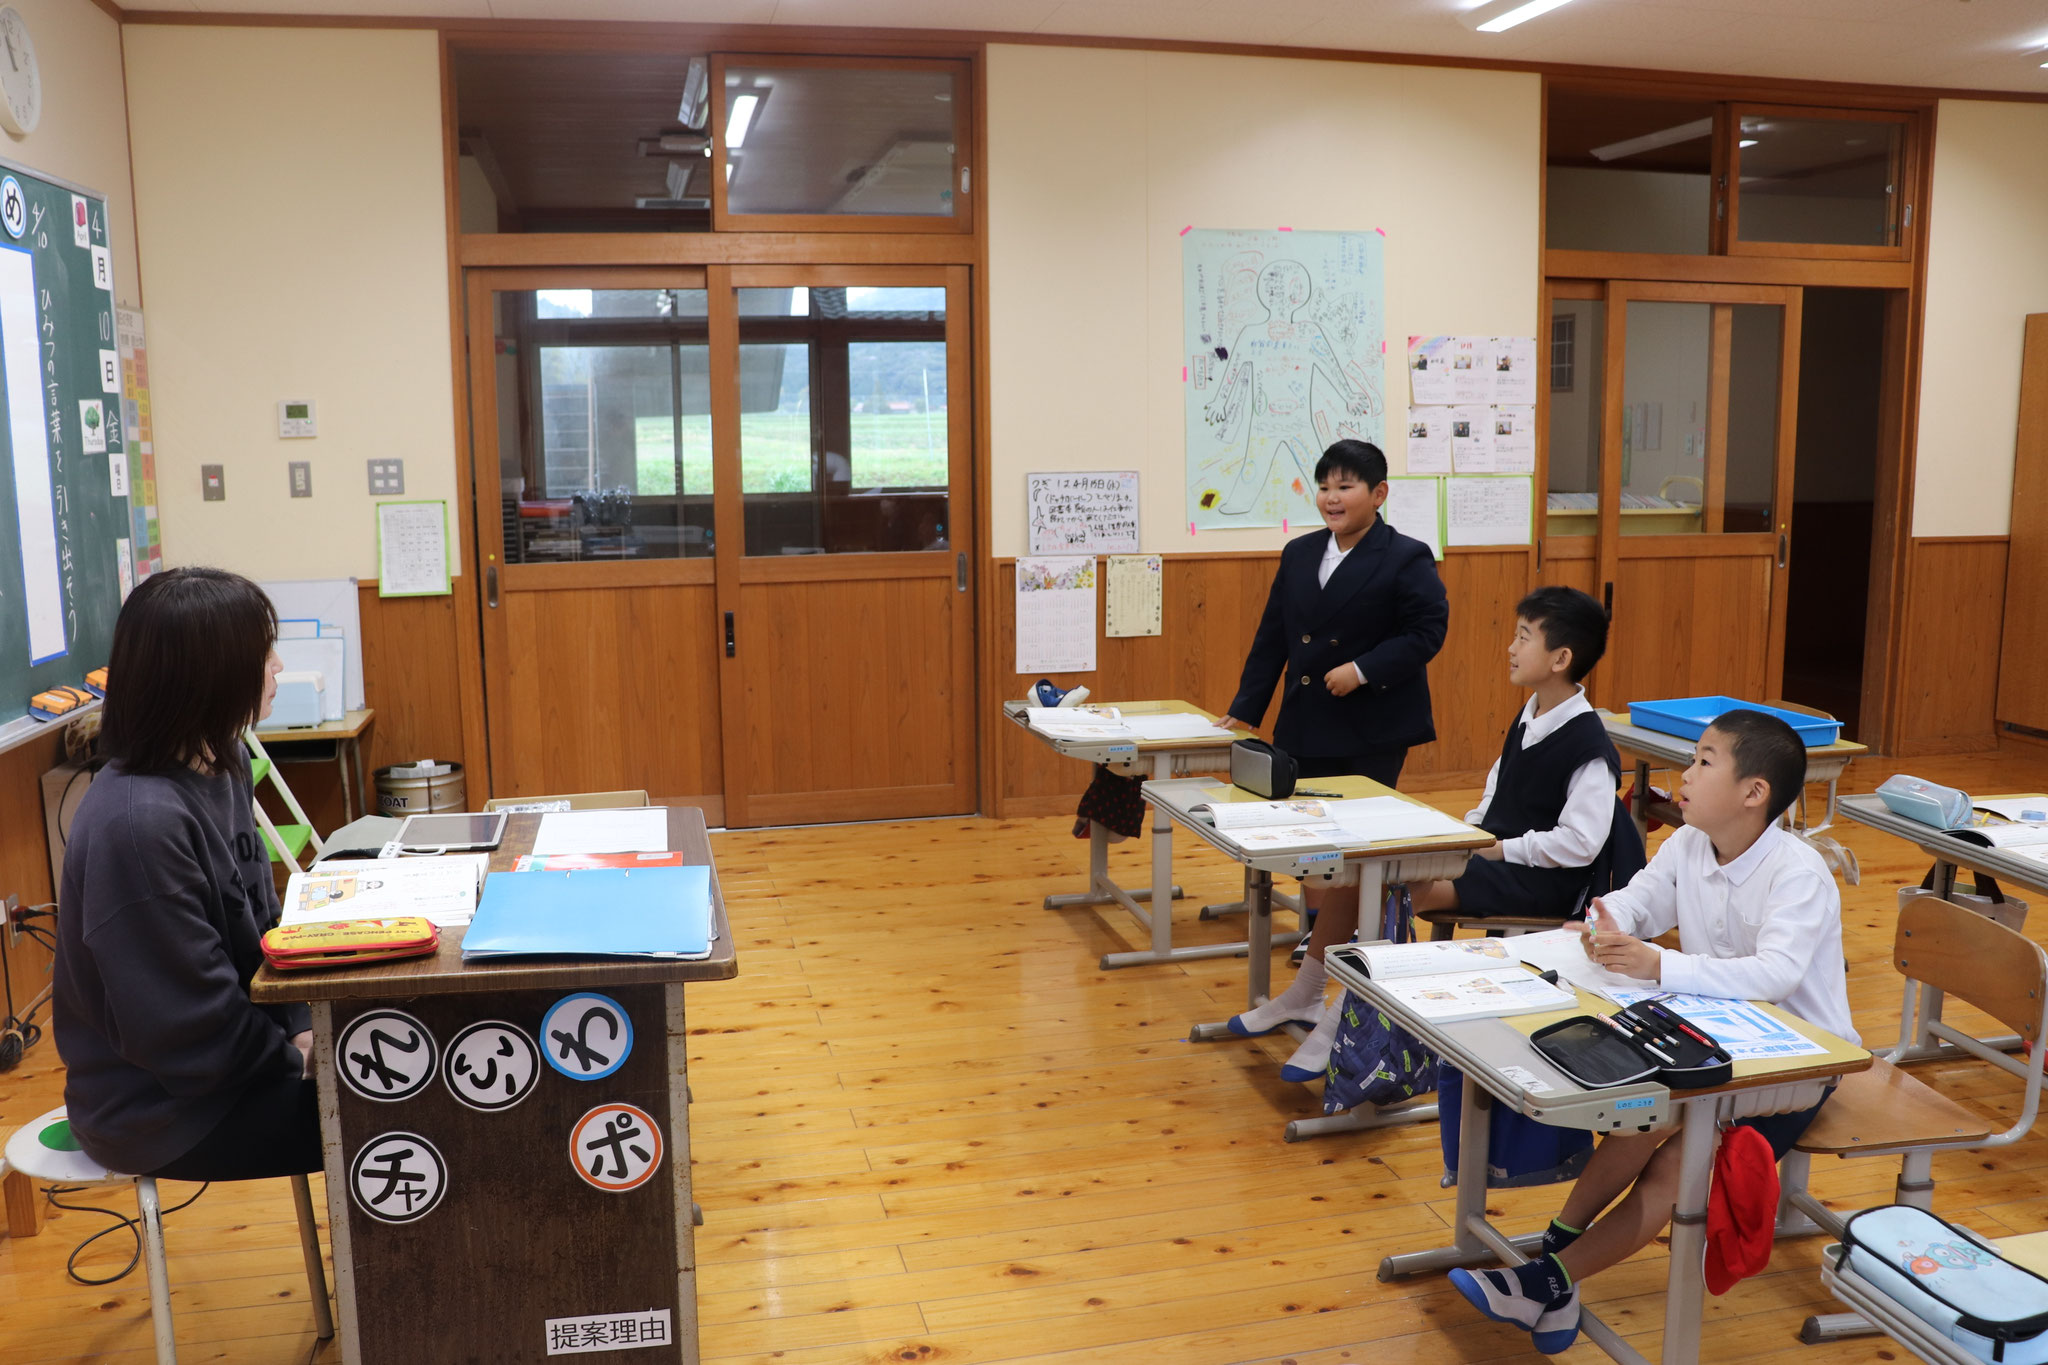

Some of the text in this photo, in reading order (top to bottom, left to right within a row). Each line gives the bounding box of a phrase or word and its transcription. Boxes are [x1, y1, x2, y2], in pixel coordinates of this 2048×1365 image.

[5, 187, 22, 227] め
[40, 287, 78, 643] ひみつの言葉を引き出そう
[350, 1029, 421, 1090] れ
[454, 1035, 517, 1096] ふ
[551, 1006, 618, 1071] わ
[586, 1112, 651, 1180] ポ
[360, 1148, 427, 1212] チャ
[550, 1315, 667, 1350] 提案理由
